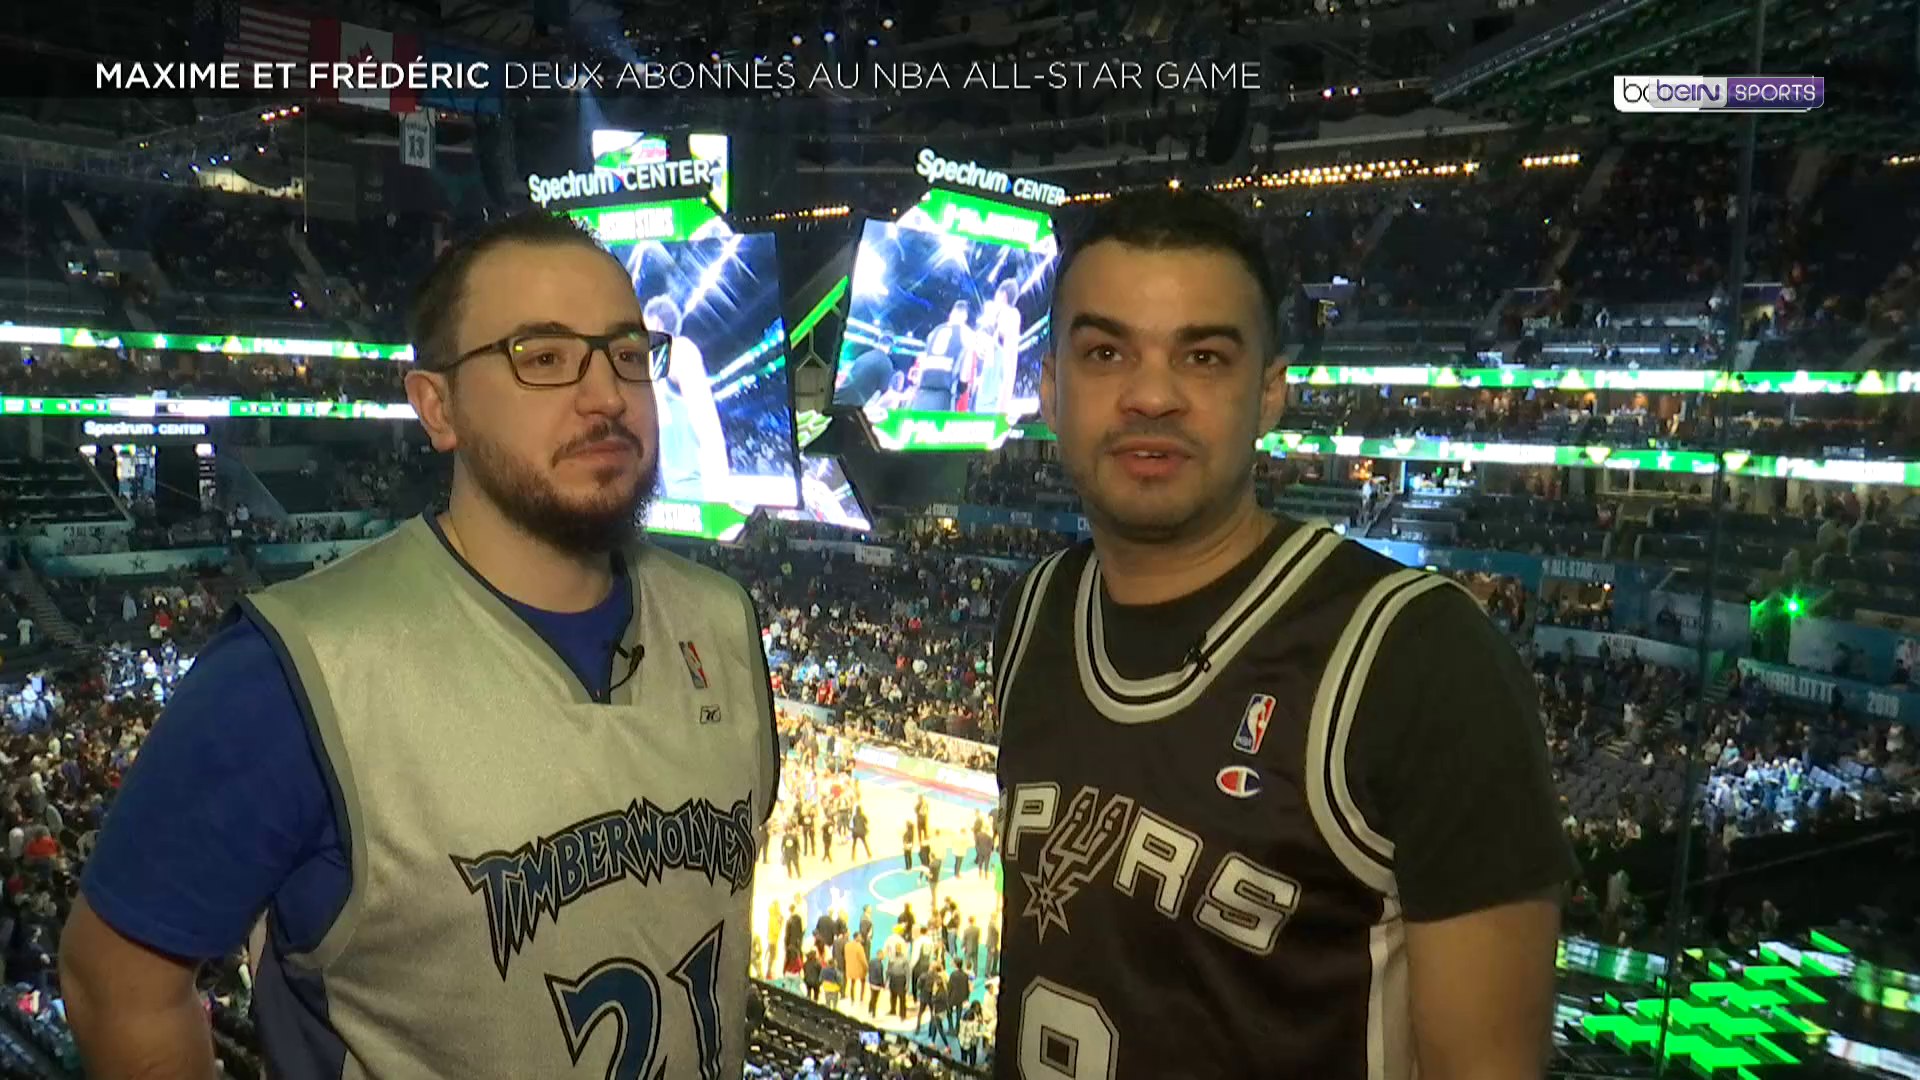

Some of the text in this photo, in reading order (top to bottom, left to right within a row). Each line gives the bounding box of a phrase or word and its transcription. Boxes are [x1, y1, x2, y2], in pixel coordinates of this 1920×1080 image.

[528, 160, 712, 209] Spectrum CENTER
[916, 147, 1066, 207] Spectrum CENTER
[84, 420, 206, 437] Spectrum CENTER
[1000, 780, 1301, 956] PURS
[544, 919, 724, 1080] 21
